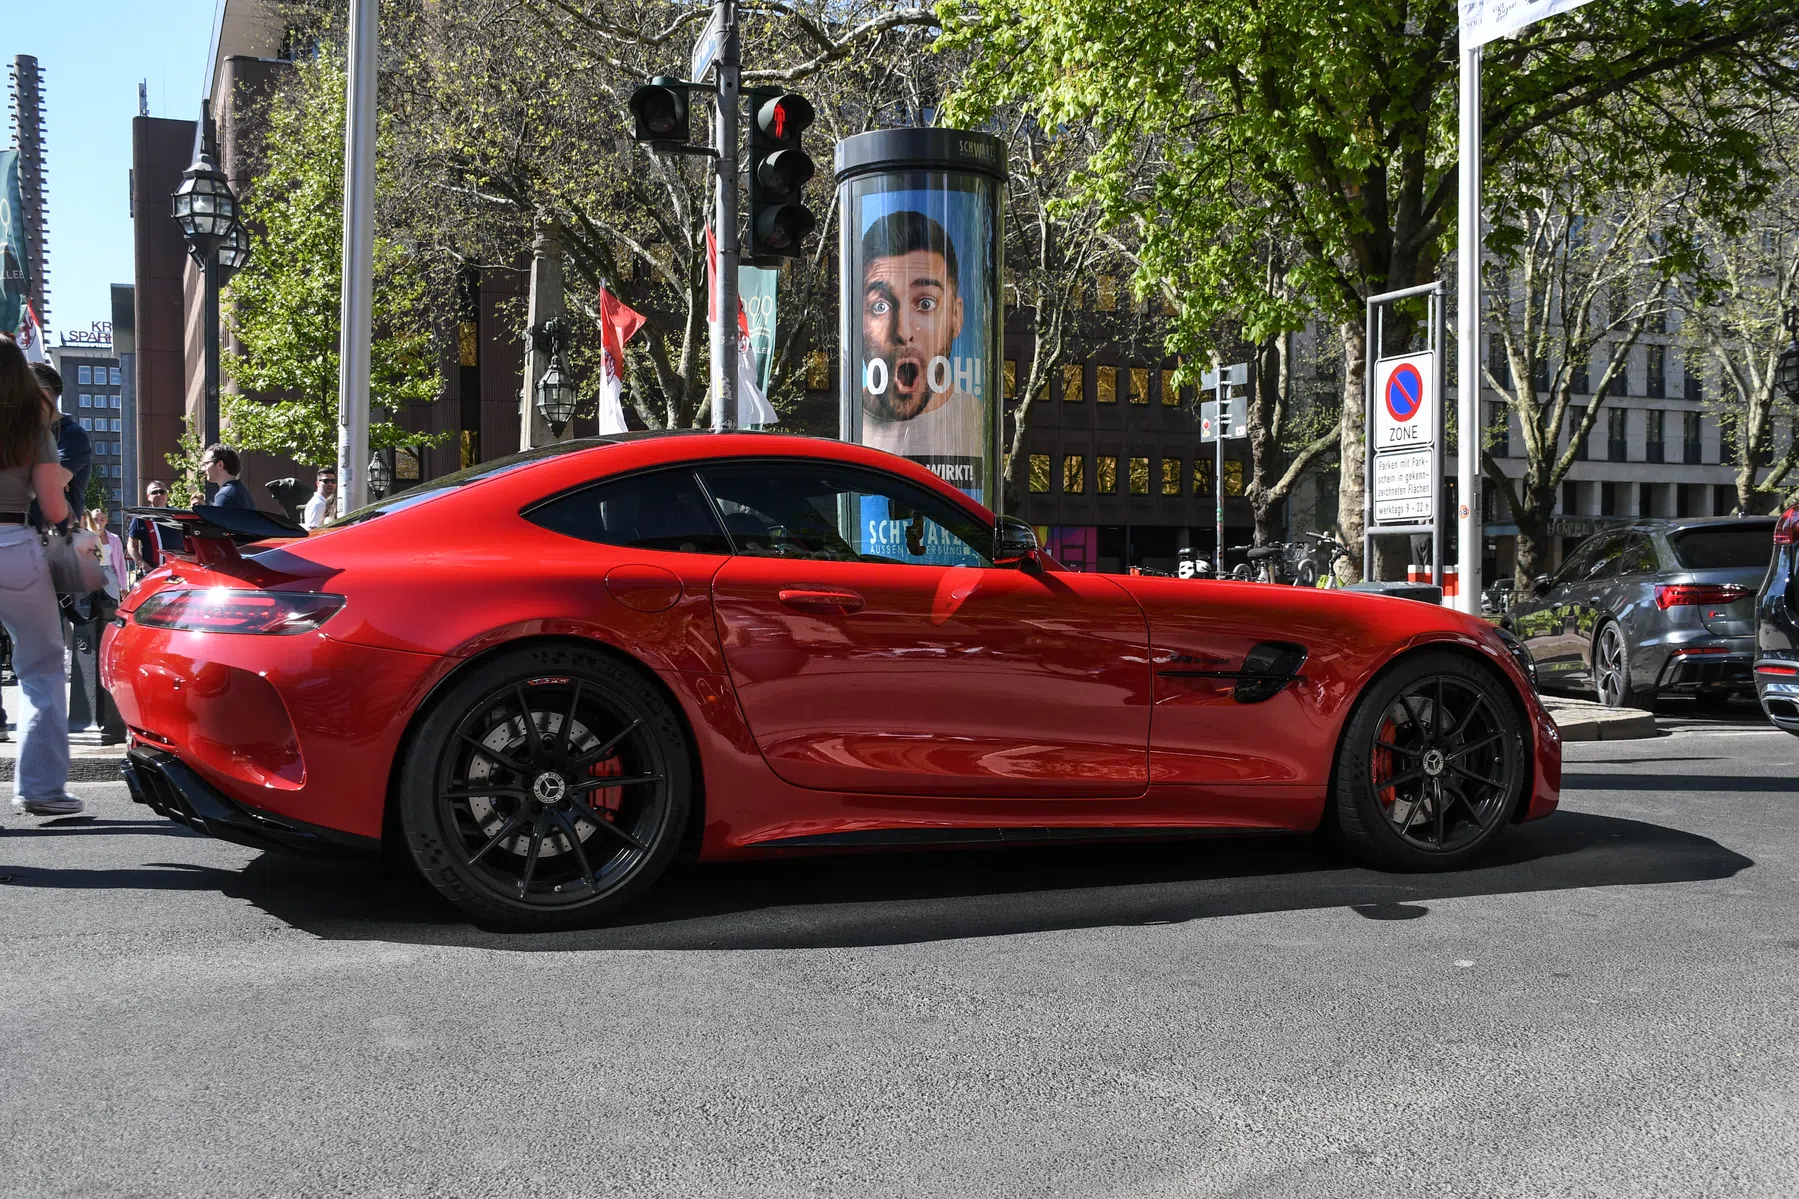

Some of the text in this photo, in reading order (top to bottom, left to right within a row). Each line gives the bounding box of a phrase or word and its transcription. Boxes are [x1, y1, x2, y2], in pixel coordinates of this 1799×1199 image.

[867, 355, 981, 396] O OH!
[1389, 425, 1418, 442] ZONE
[1379, 456, 1428, 471] Parken mit Park-
[1378, 471, 1429, 484] schein in gekenn-
[1378, 483, 1430, 498] zeichneten Flächen
[1379, 504, 1404, 517] werktags
[1406, 503, 1410, 513] 9
[1416, 501, 1423, 513] 22
[1425, 501, 1430, 512] h
[1546, 522, 1590, 535] HOTEL
[870, 544, 963, 556] AUSSENERBUNG
